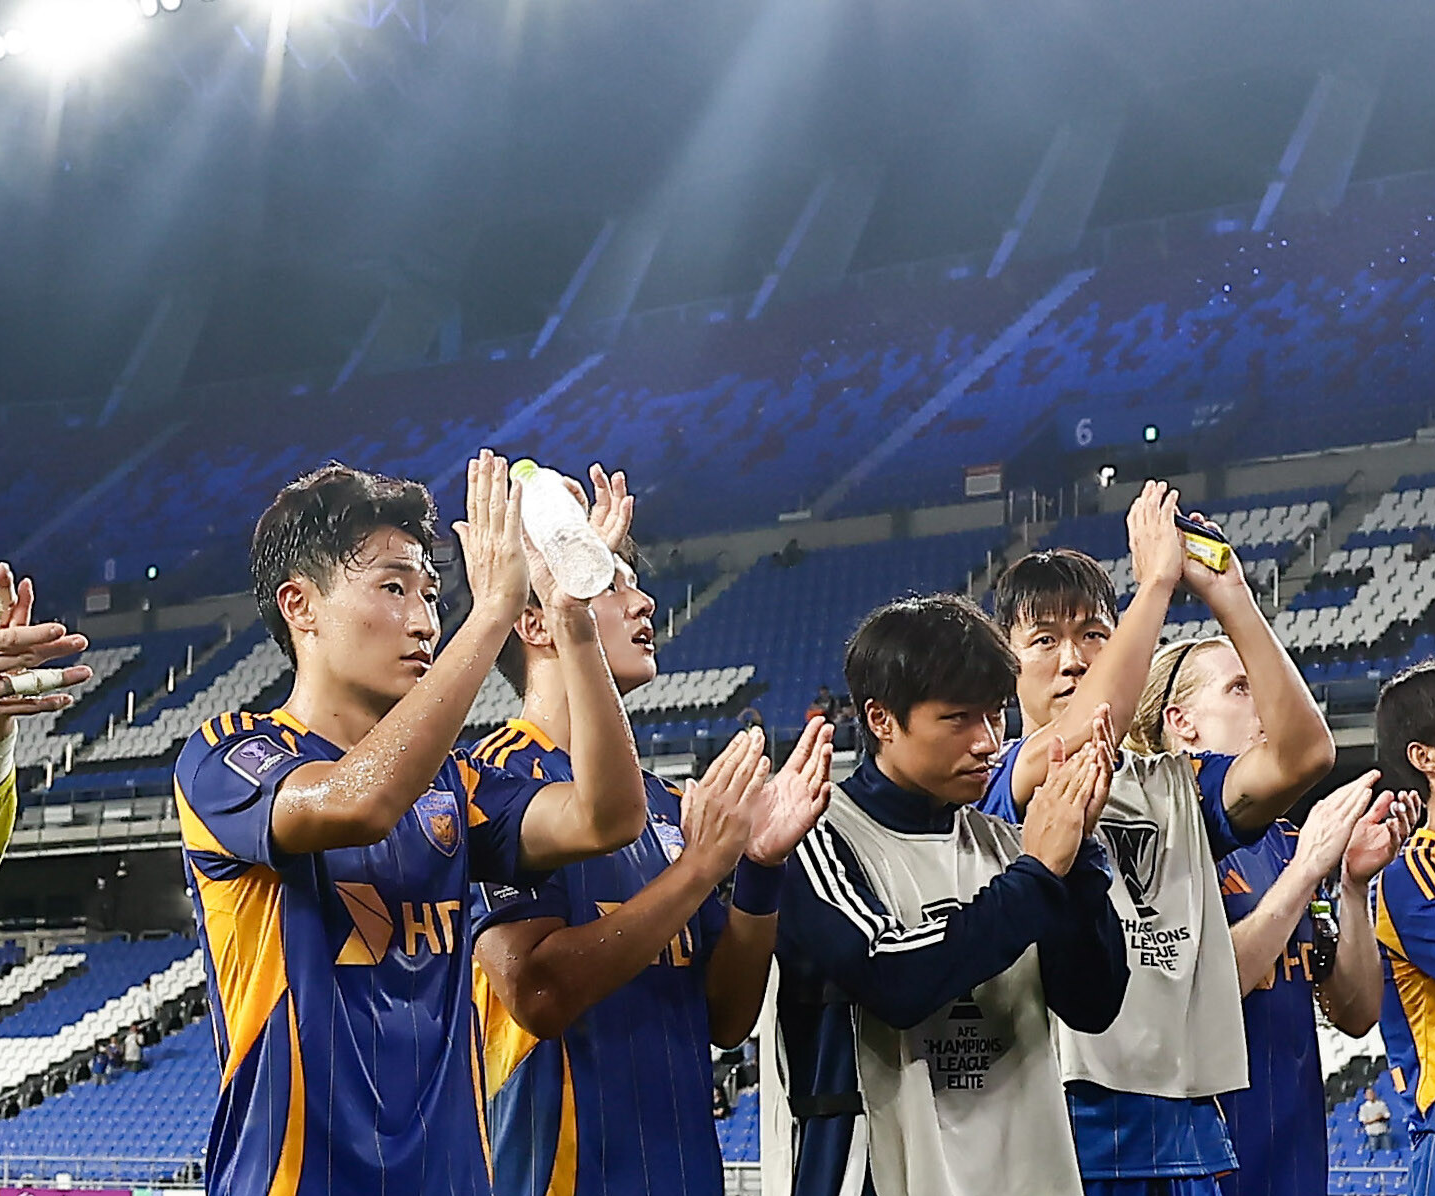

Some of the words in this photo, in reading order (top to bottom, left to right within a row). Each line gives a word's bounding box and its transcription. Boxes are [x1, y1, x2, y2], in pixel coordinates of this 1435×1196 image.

[1076, 418, 1094, 446] 6
[958, 1027, 978, 1037] AFC
[937, 1056, 990, 1072] LEAGUE
[947, 1074, 984, 1089] ELITE
